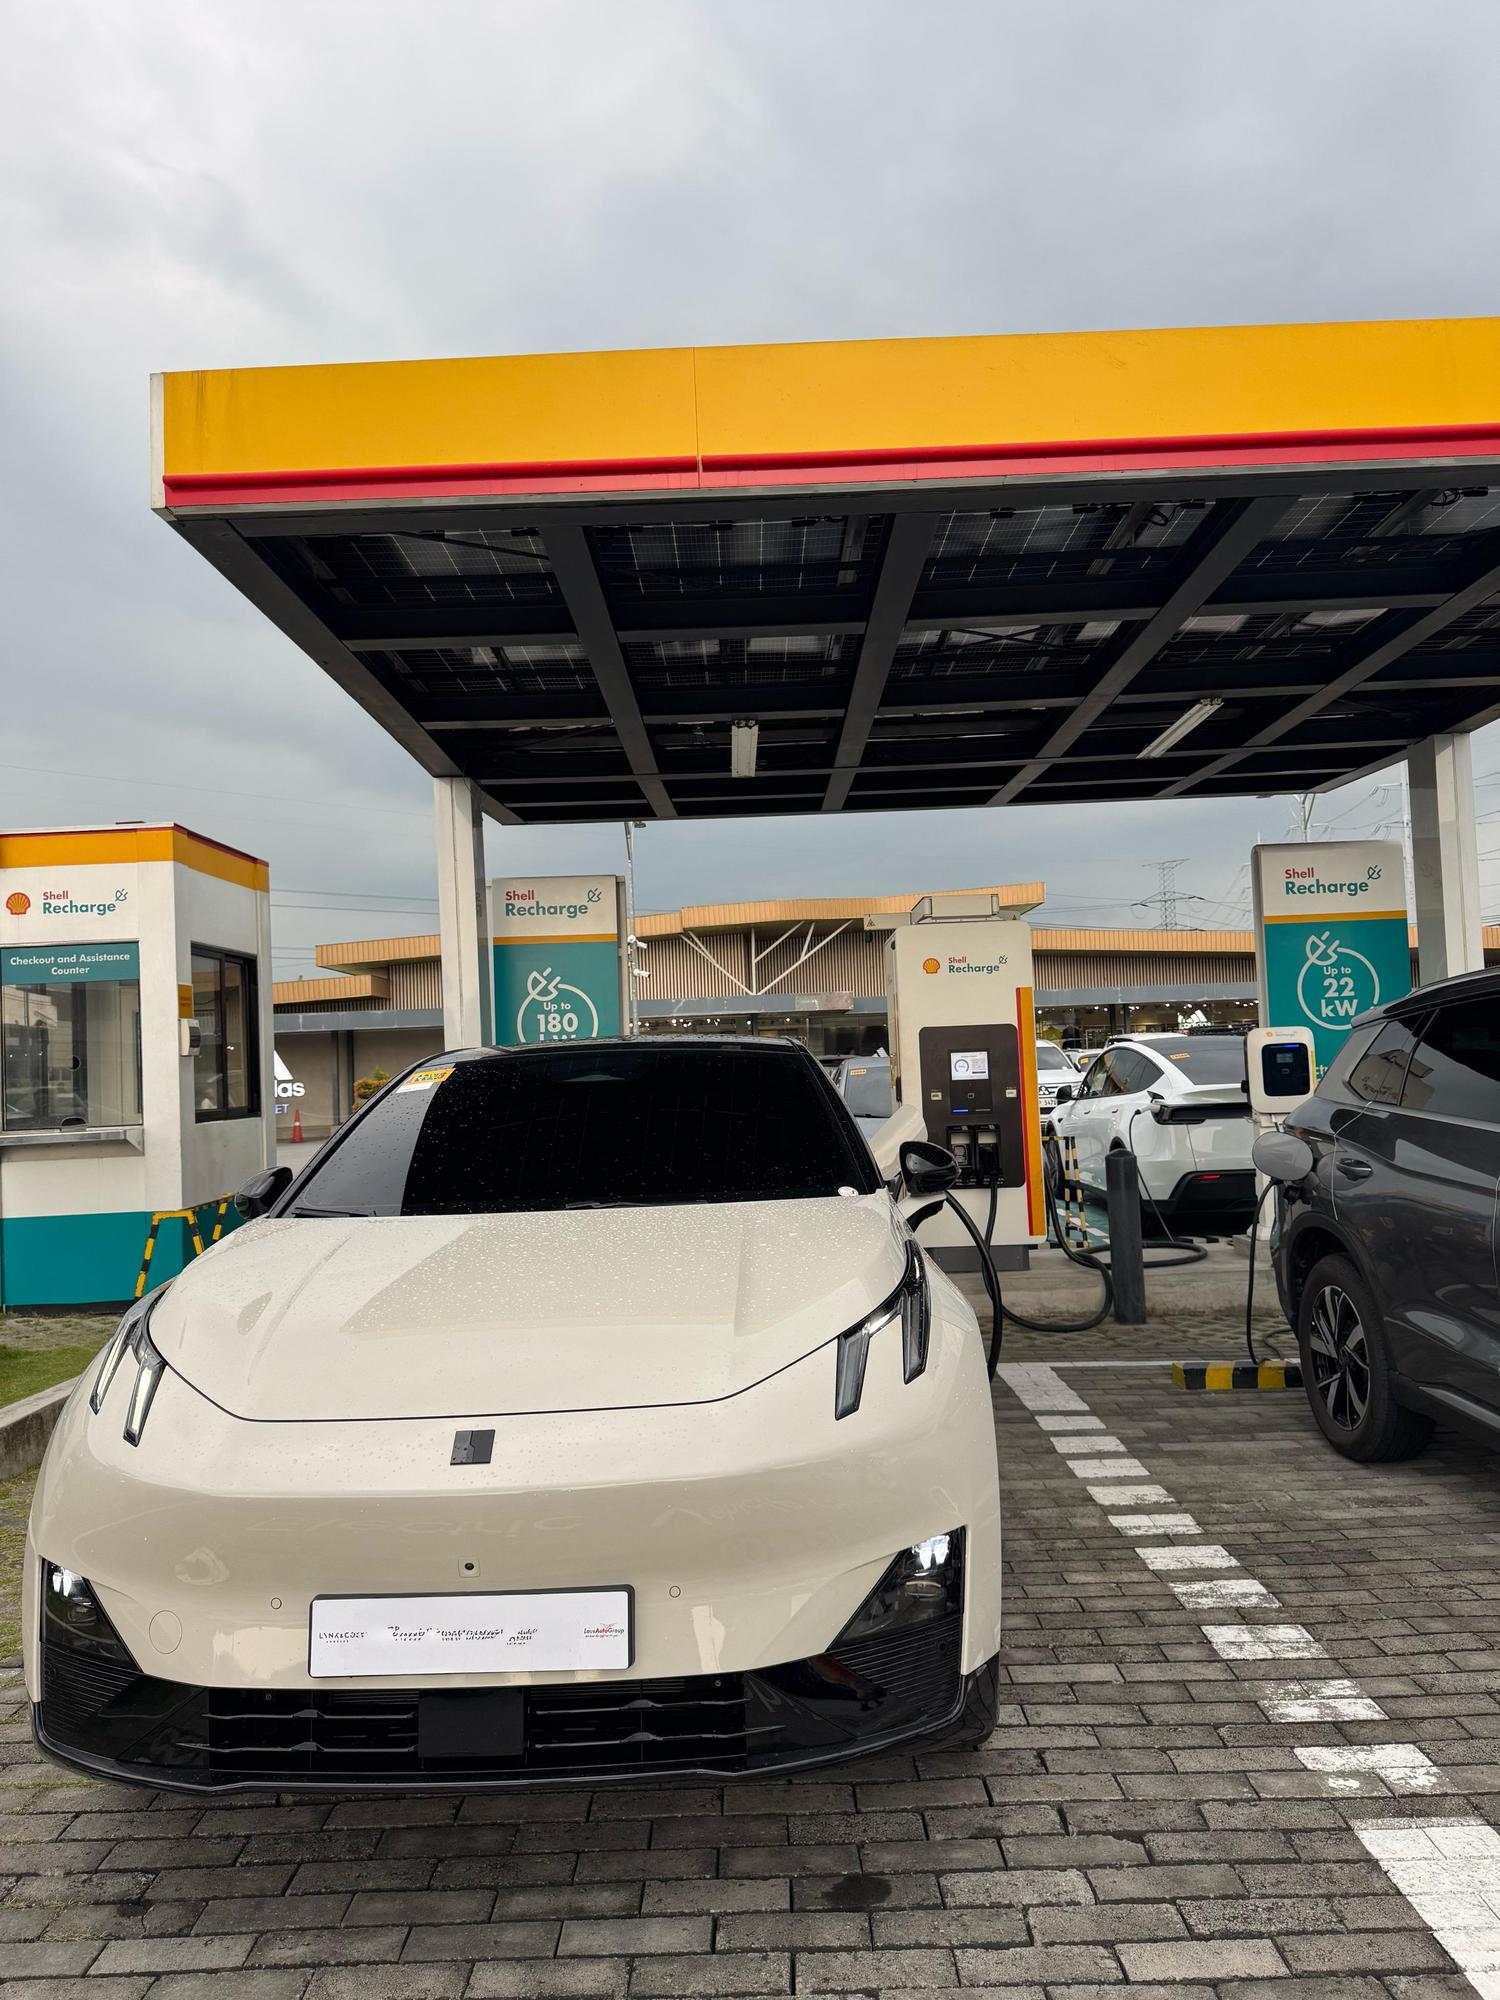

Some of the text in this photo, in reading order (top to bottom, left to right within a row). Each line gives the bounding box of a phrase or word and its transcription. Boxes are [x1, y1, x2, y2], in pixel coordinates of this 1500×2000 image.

[1285, 868, 1314, 879] Shell
[1285, 879, 1368, 896] Recharge
[43, 890, 69, 901] Shell
[505, 890, 535, 901] Shell
[43, 900, 116, 916] Recharge
[505, 901, 589, 918] Recharge
[10, 952, 131, 966] Checkout and Assistance
[948, 956, 967, 964] Shell
[51, 966, 90, 975] Counter
[948, 963, 1000, 974] Recharge
[1323, 966, 1351, 977] Up to
[1323, 977, 1355, 998] 22
[543, 1001, 571, 1012] Up to
[1321, 999, 1358, 1018] kW
[537, 1012, 578, 1033] 180
